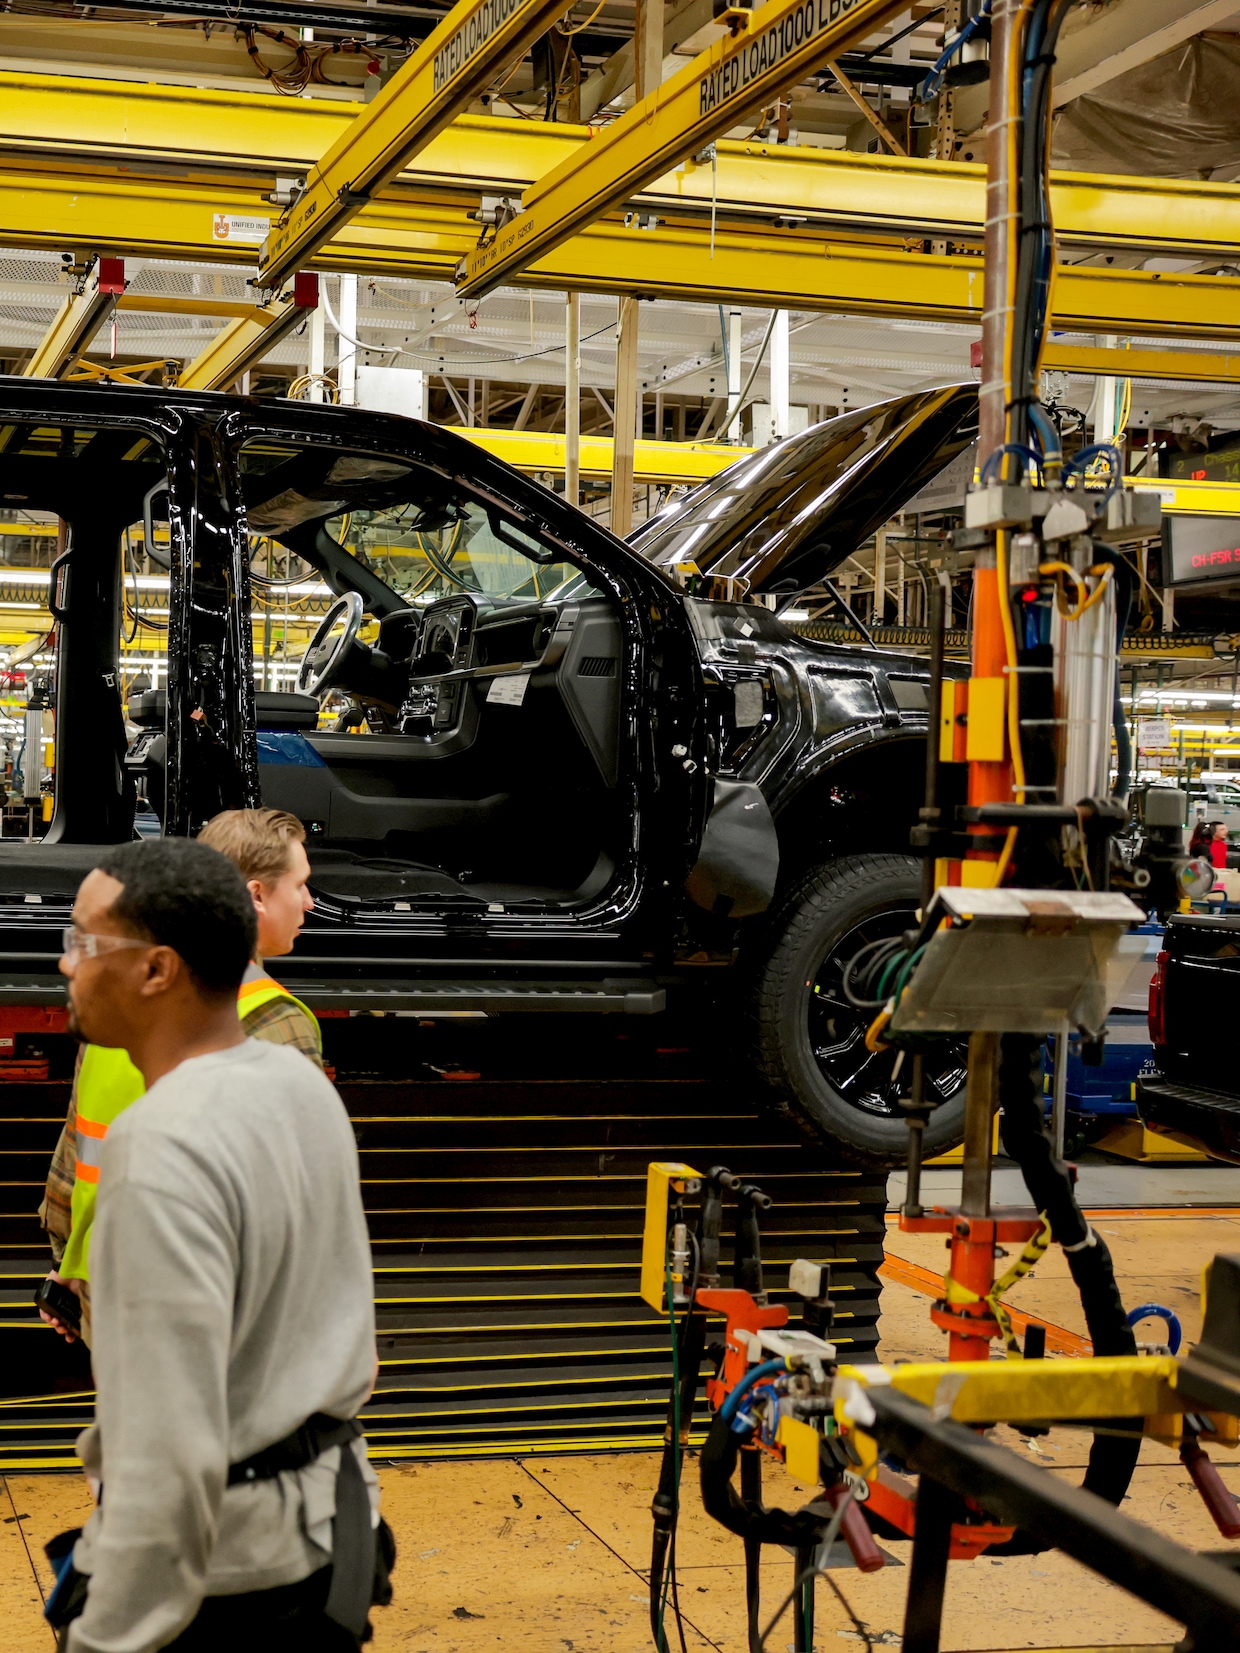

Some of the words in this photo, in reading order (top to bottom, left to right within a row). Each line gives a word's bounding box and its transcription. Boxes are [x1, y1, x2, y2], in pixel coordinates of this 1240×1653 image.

[700, 55, 739, 116] RATED
[231, 220, 255, 229] UNIFIED
[1176, 459, 1185, 473] 2
[1191, 550, 1232, 568] CH-FSR
